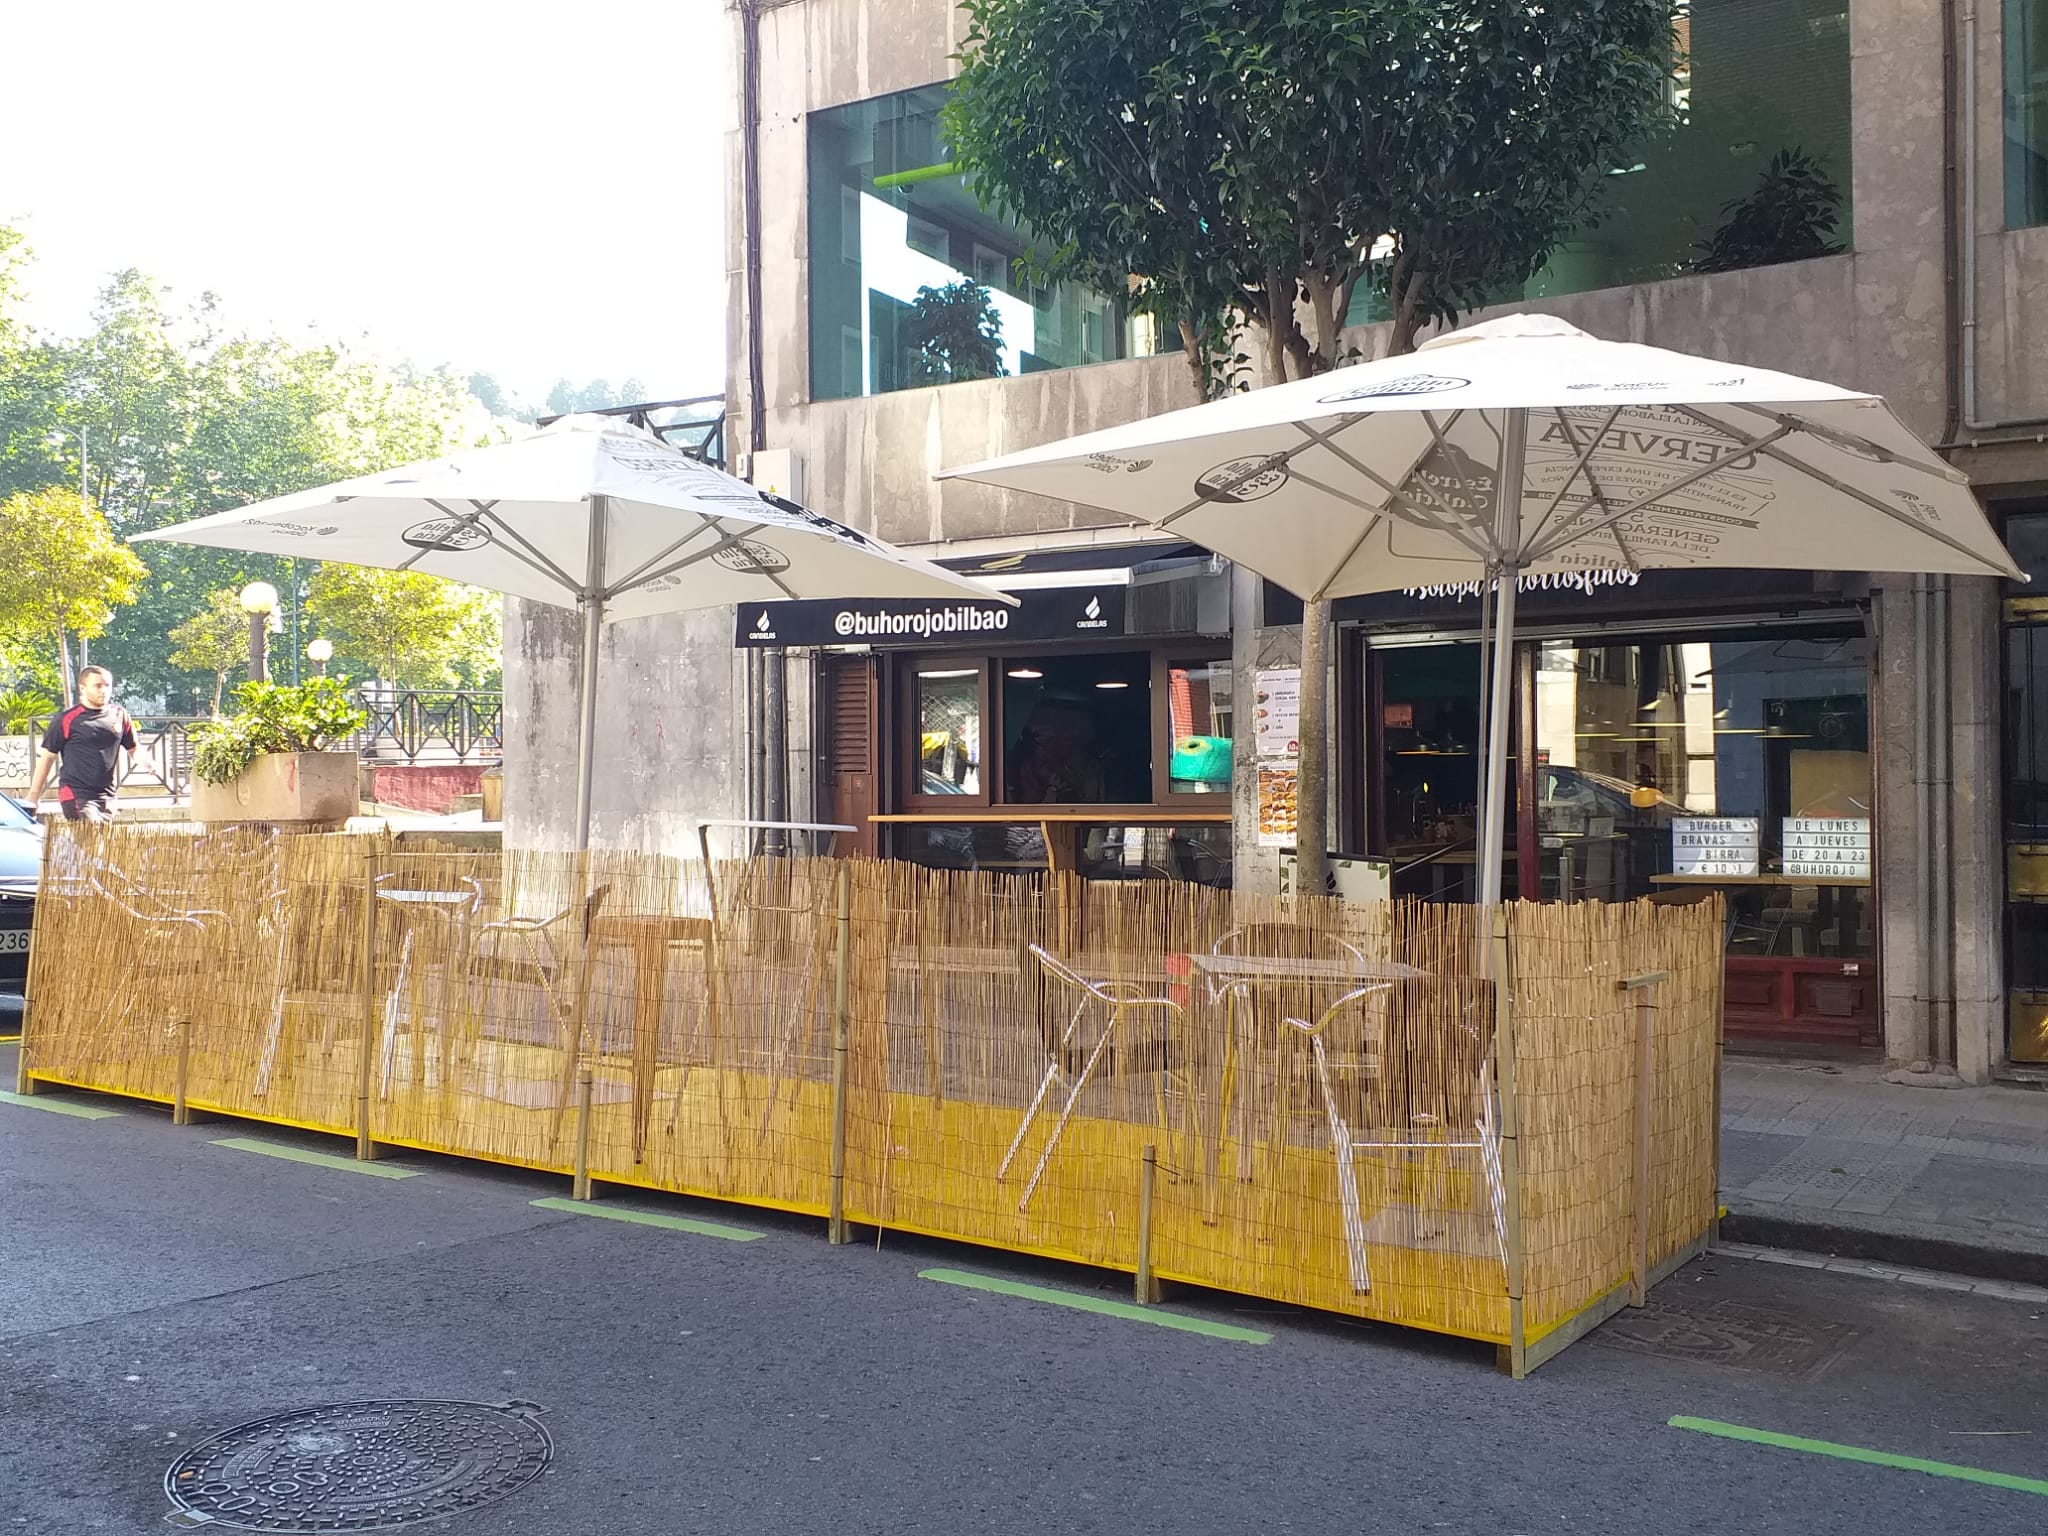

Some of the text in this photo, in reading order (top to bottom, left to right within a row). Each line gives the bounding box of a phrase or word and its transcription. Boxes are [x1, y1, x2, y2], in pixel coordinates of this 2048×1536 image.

[834, 606, 1009, 638] @buhorojobilbao
[1076, 618, 1108, 629] CANDELAS
[1689, 819, 1733, 831] BURGER
[1795, 820, 1858, 831] DE LUNES
[1681, 834, 1726, 845] BRAVAS
[1796, 835, 1856, 846] A JUEVES
[1705, 849, 1741, 860] BIRRA
[1791, 850, 1865, 861] DE 20 A 23
